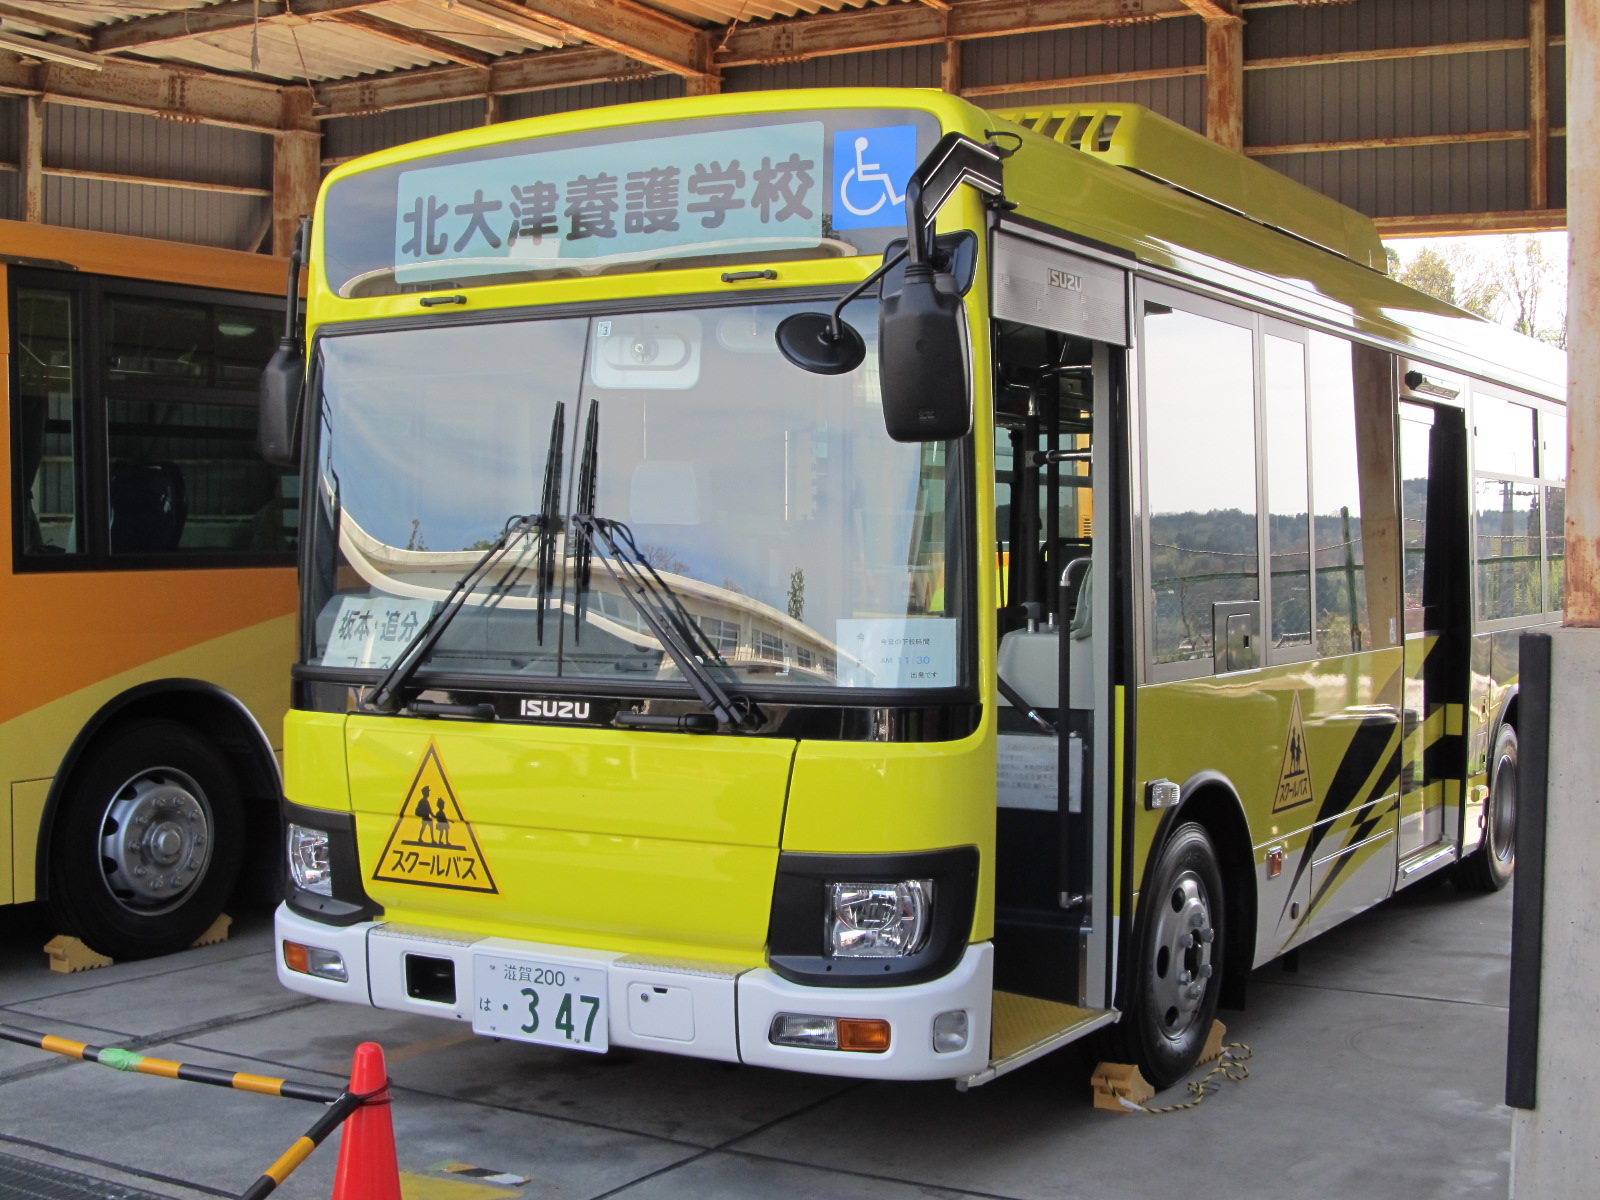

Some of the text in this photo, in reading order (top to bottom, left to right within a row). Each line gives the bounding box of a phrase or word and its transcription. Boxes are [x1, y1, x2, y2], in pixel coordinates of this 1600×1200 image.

[401, 152, 816, 257] 北大津養護学校
[1048, 268, 1082, 292] ISUZU
[880, 638, 931, 646] 今日の下校時間
[910, 671, 938, 679] 出発です
[520, 699, 590, 719] ISUZU
[1280, 778, 1307, 802] スクールバス
[391, 850, 477, 880] スクールバス
[479, 996, 492, 1013] は
